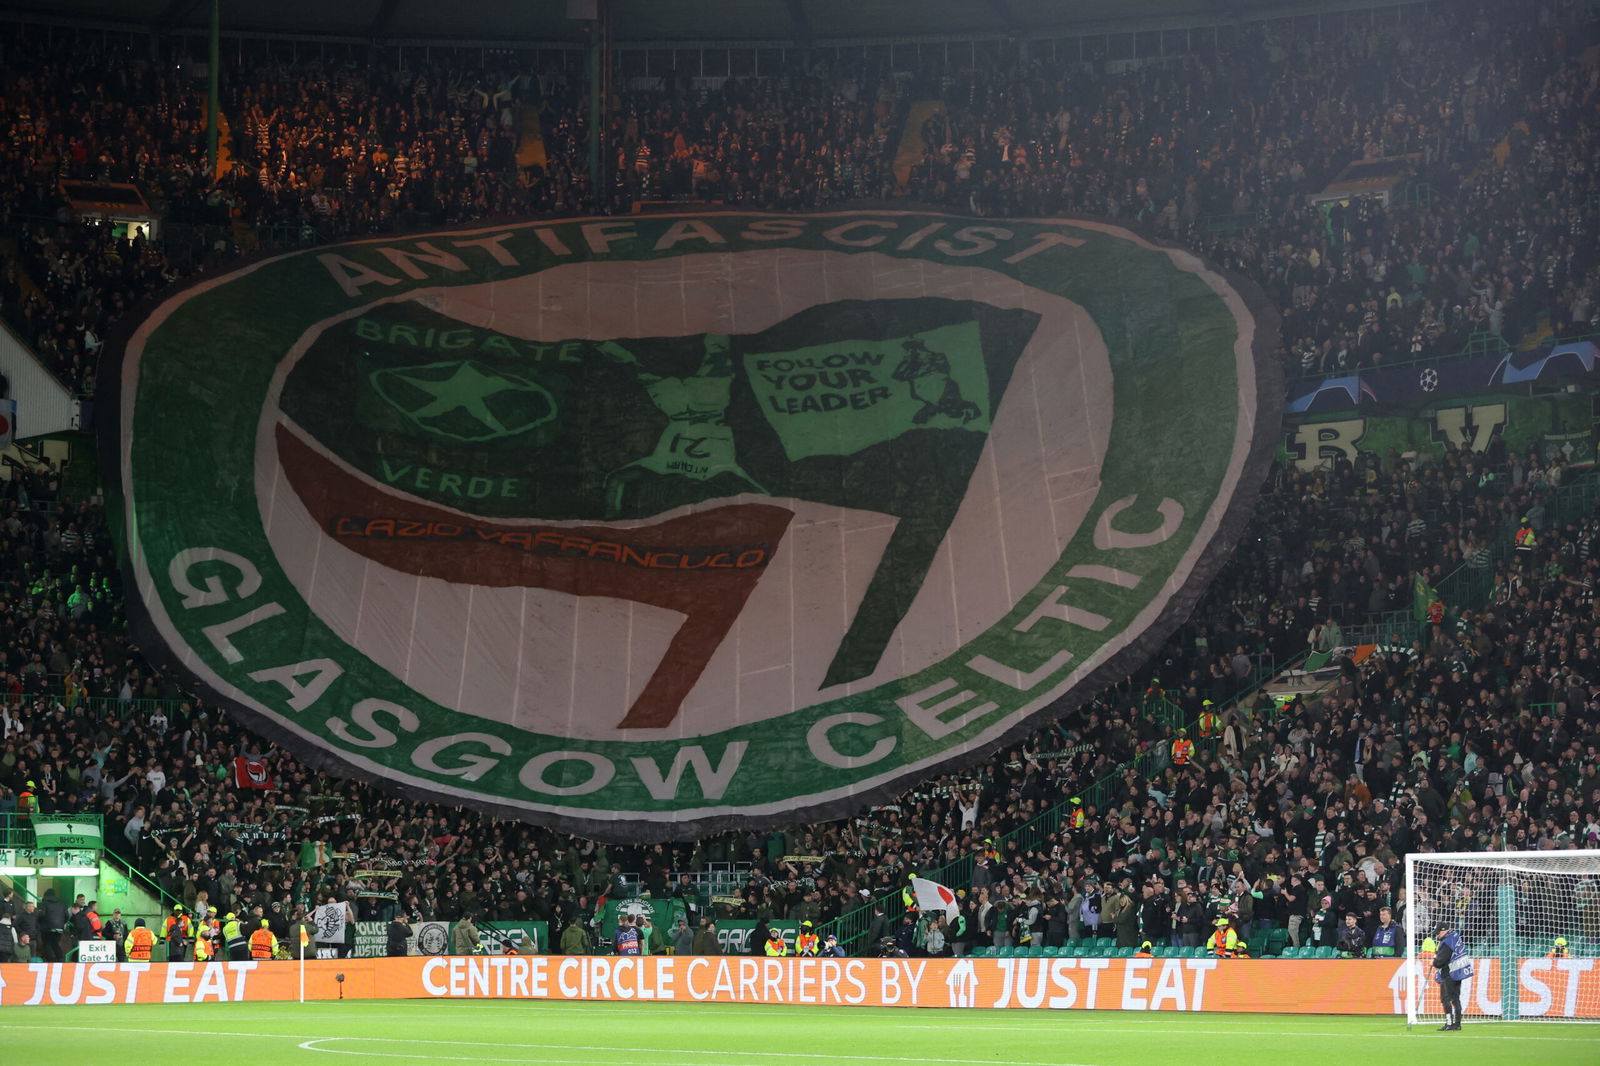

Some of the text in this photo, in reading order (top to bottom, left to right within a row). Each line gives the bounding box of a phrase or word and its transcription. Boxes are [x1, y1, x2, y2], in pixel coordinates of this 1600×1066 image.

[316, 213, 1088, 298] ANTIFASCIST
[354, 317, 583, 363] BRIGATE
[756, 351, 885, 372] FOLLOW
[761, 368, 879, 392] YOUR
[767, 386, 893, 415] LEADER
[381, 459, 521, 499] VERDE
[335, 516, 768, 570] LAZIO VAFFANCULO
[168, 493, 1185, 803] GLASGOW CELTIC
[59, 836, 85, 845] BHOYS
[80, 953, 116, 962] Gate 14
[88, 943, 107, 952] Exit
[354, 944, 388, 957] JUSTICE
[25, 961, 258, 1005] JUST EAT
[421, 956, 927, 1006] CENTRE CIRCLE CARRIERS BY
[993, 958, 1218, 1012] JUST EAT
